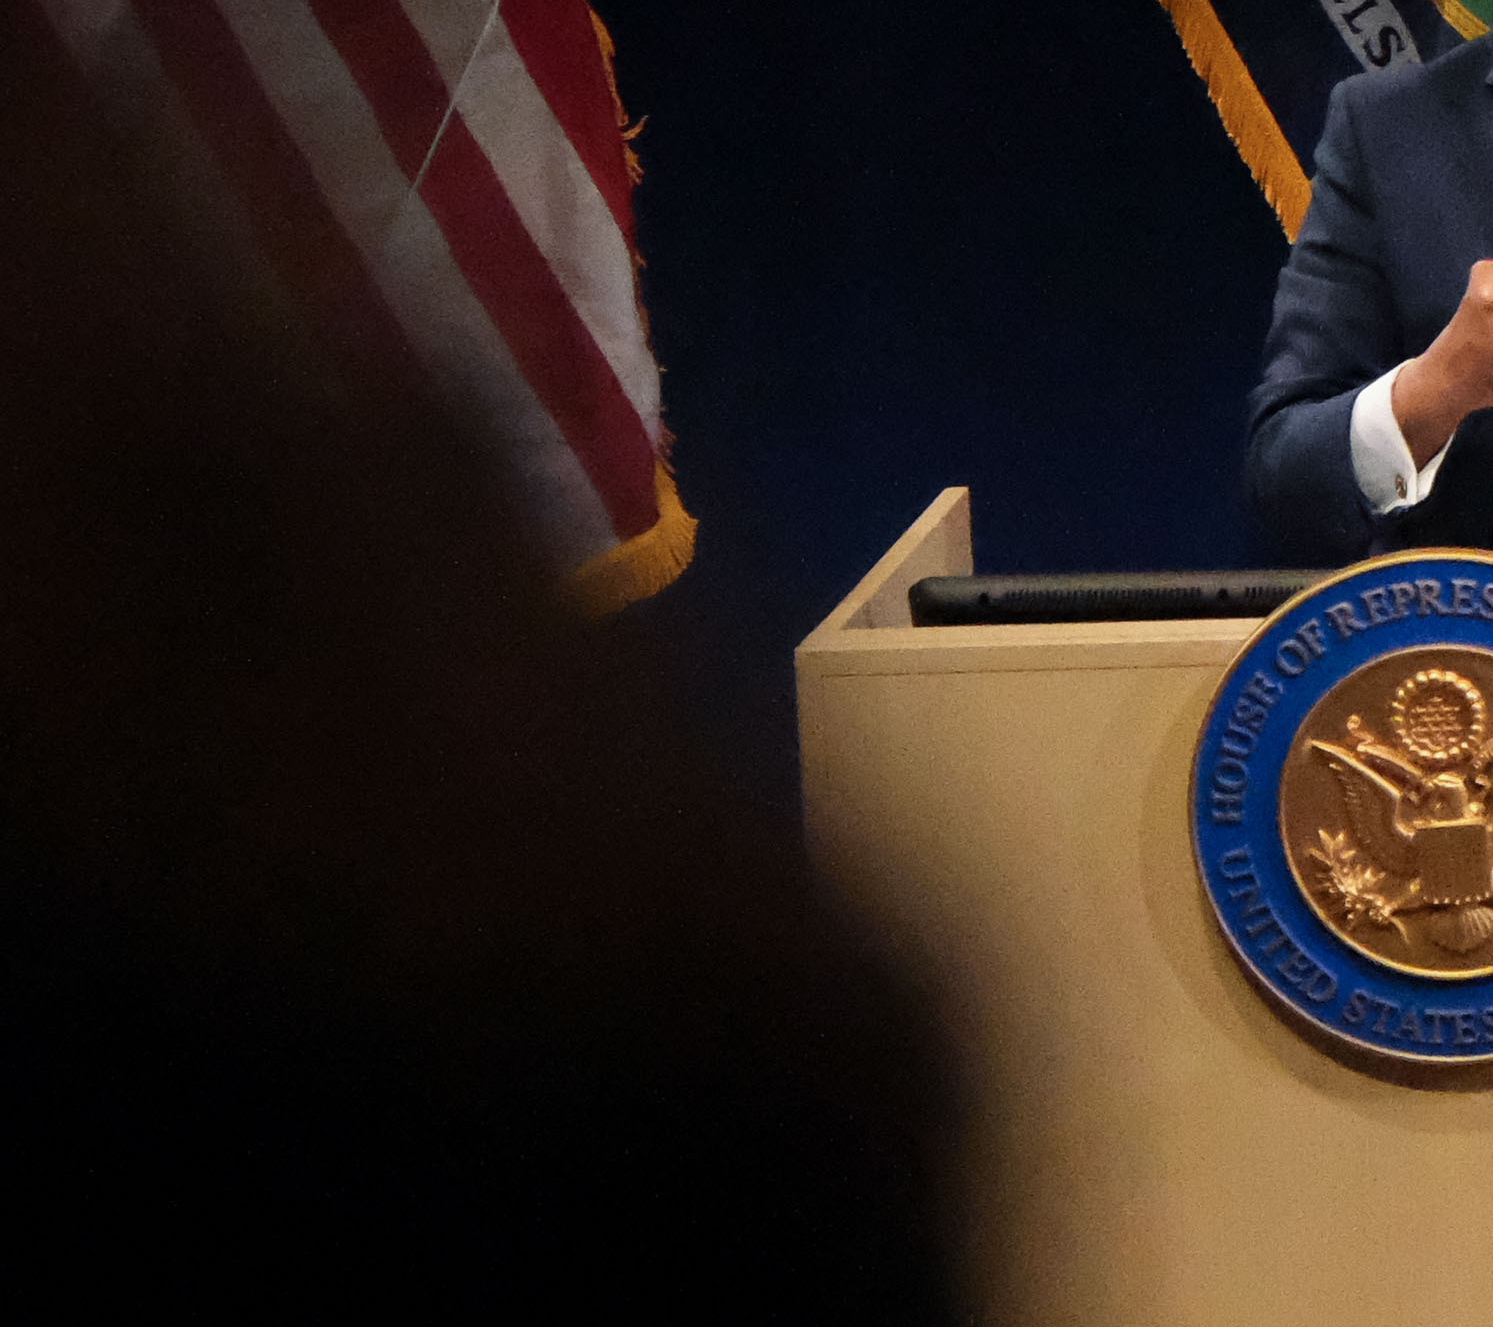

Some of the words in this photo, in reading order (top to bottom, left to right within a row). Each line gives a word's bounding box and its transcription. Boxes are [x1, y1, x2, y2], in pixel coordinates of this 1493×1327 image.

[1212, 671, 1284, 823] HOUSE
[1275, 617, 1327, 677] OF
[1221, 844, 1338, 1002] UNITED
